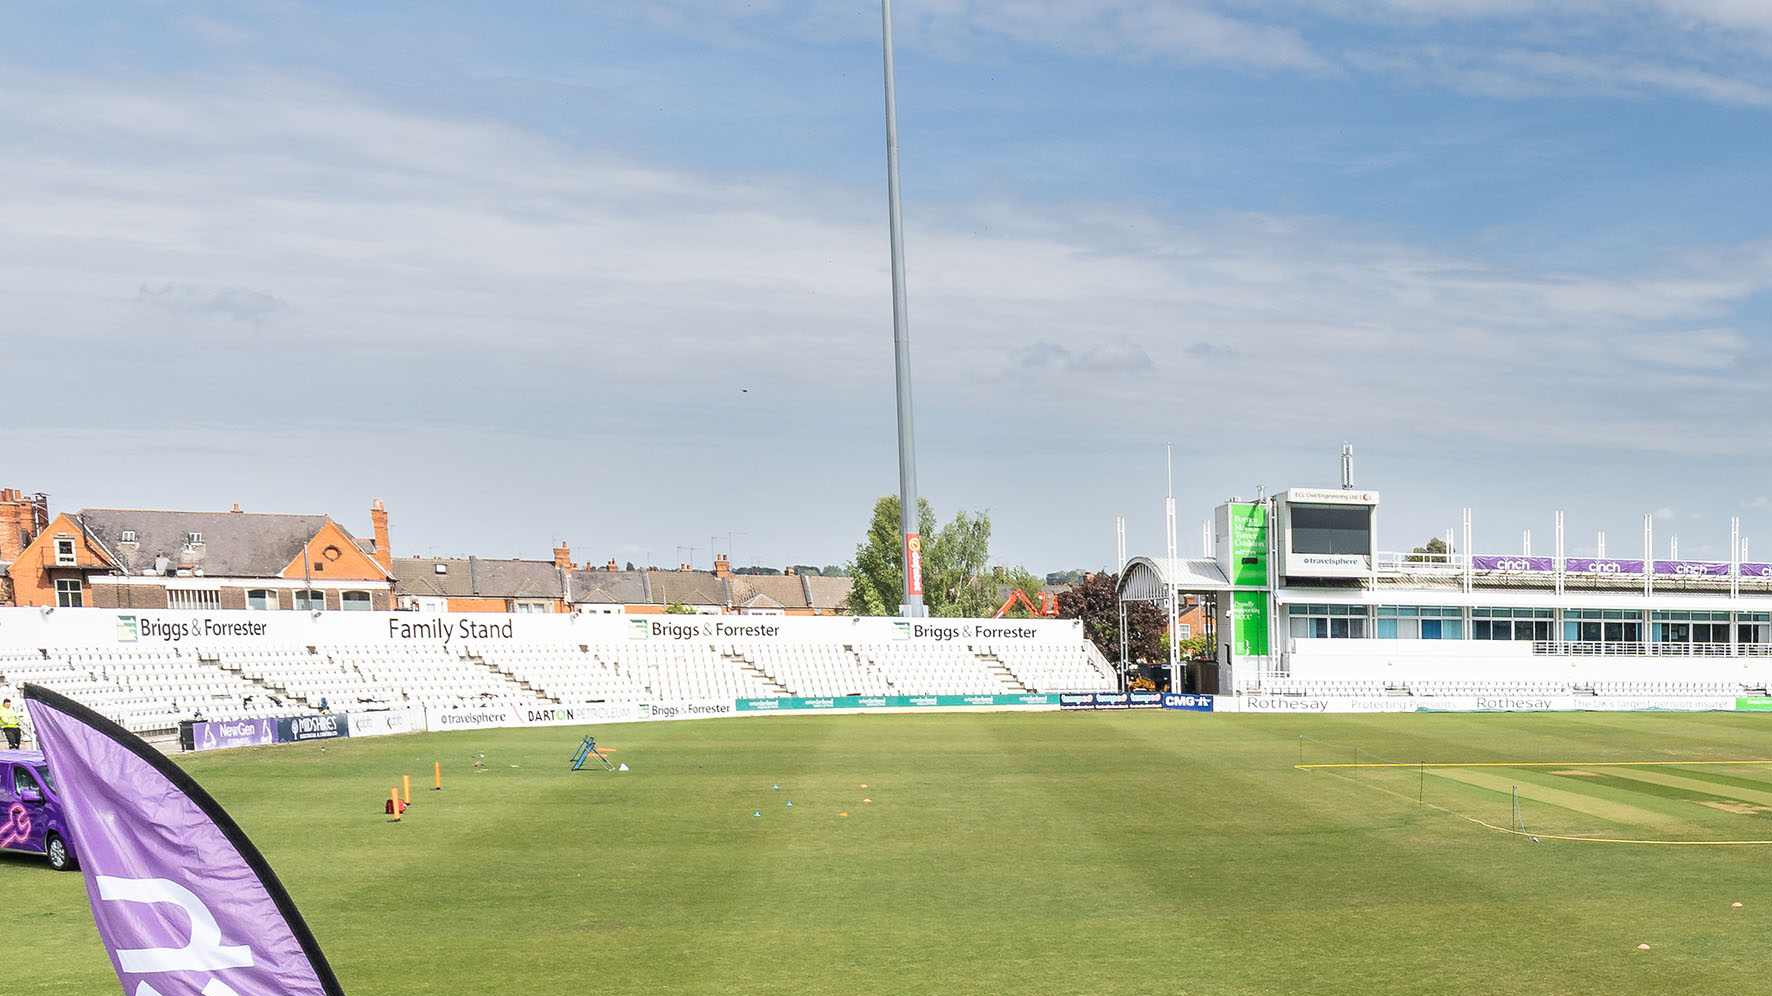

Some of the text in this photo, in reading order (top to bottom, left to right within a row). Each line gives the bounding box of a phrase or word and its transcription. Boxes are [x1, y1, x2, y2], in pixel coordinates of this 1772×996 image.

[1309, 557, 1359, 566] travelsphere
[1497, 557, 1530, 570] cinch
[1588, 559, 1621, 573] cinch
[1676, 562, 1708, 576] cinch
[140, 618, 267, 641] Briggs & Forrester
[388, 618, 513, 644] Family Stand
[652, 621, 780, 640] Briggs & Forrester
[914, 624, 1037, 641] Briggs & Forrester
[1165, 695, 1195, 707] CMG
[1247, 696, 1328, 712] Rothesay
[1351, 699, 1406, 710] Protecting
[1477, 697, 1551, 710] Rothesay
[1573, 698, 1591, 708] The
[1695, 699, 1728, 709] insurer
[527, 708, 574, 722] BARTON
[651, 704, 680, 717] Briggs
[688, 702, 730, 714] Forrester
[447, 712, 506, 725] travelsphere
[219, 723, 255, 737] NewGen
